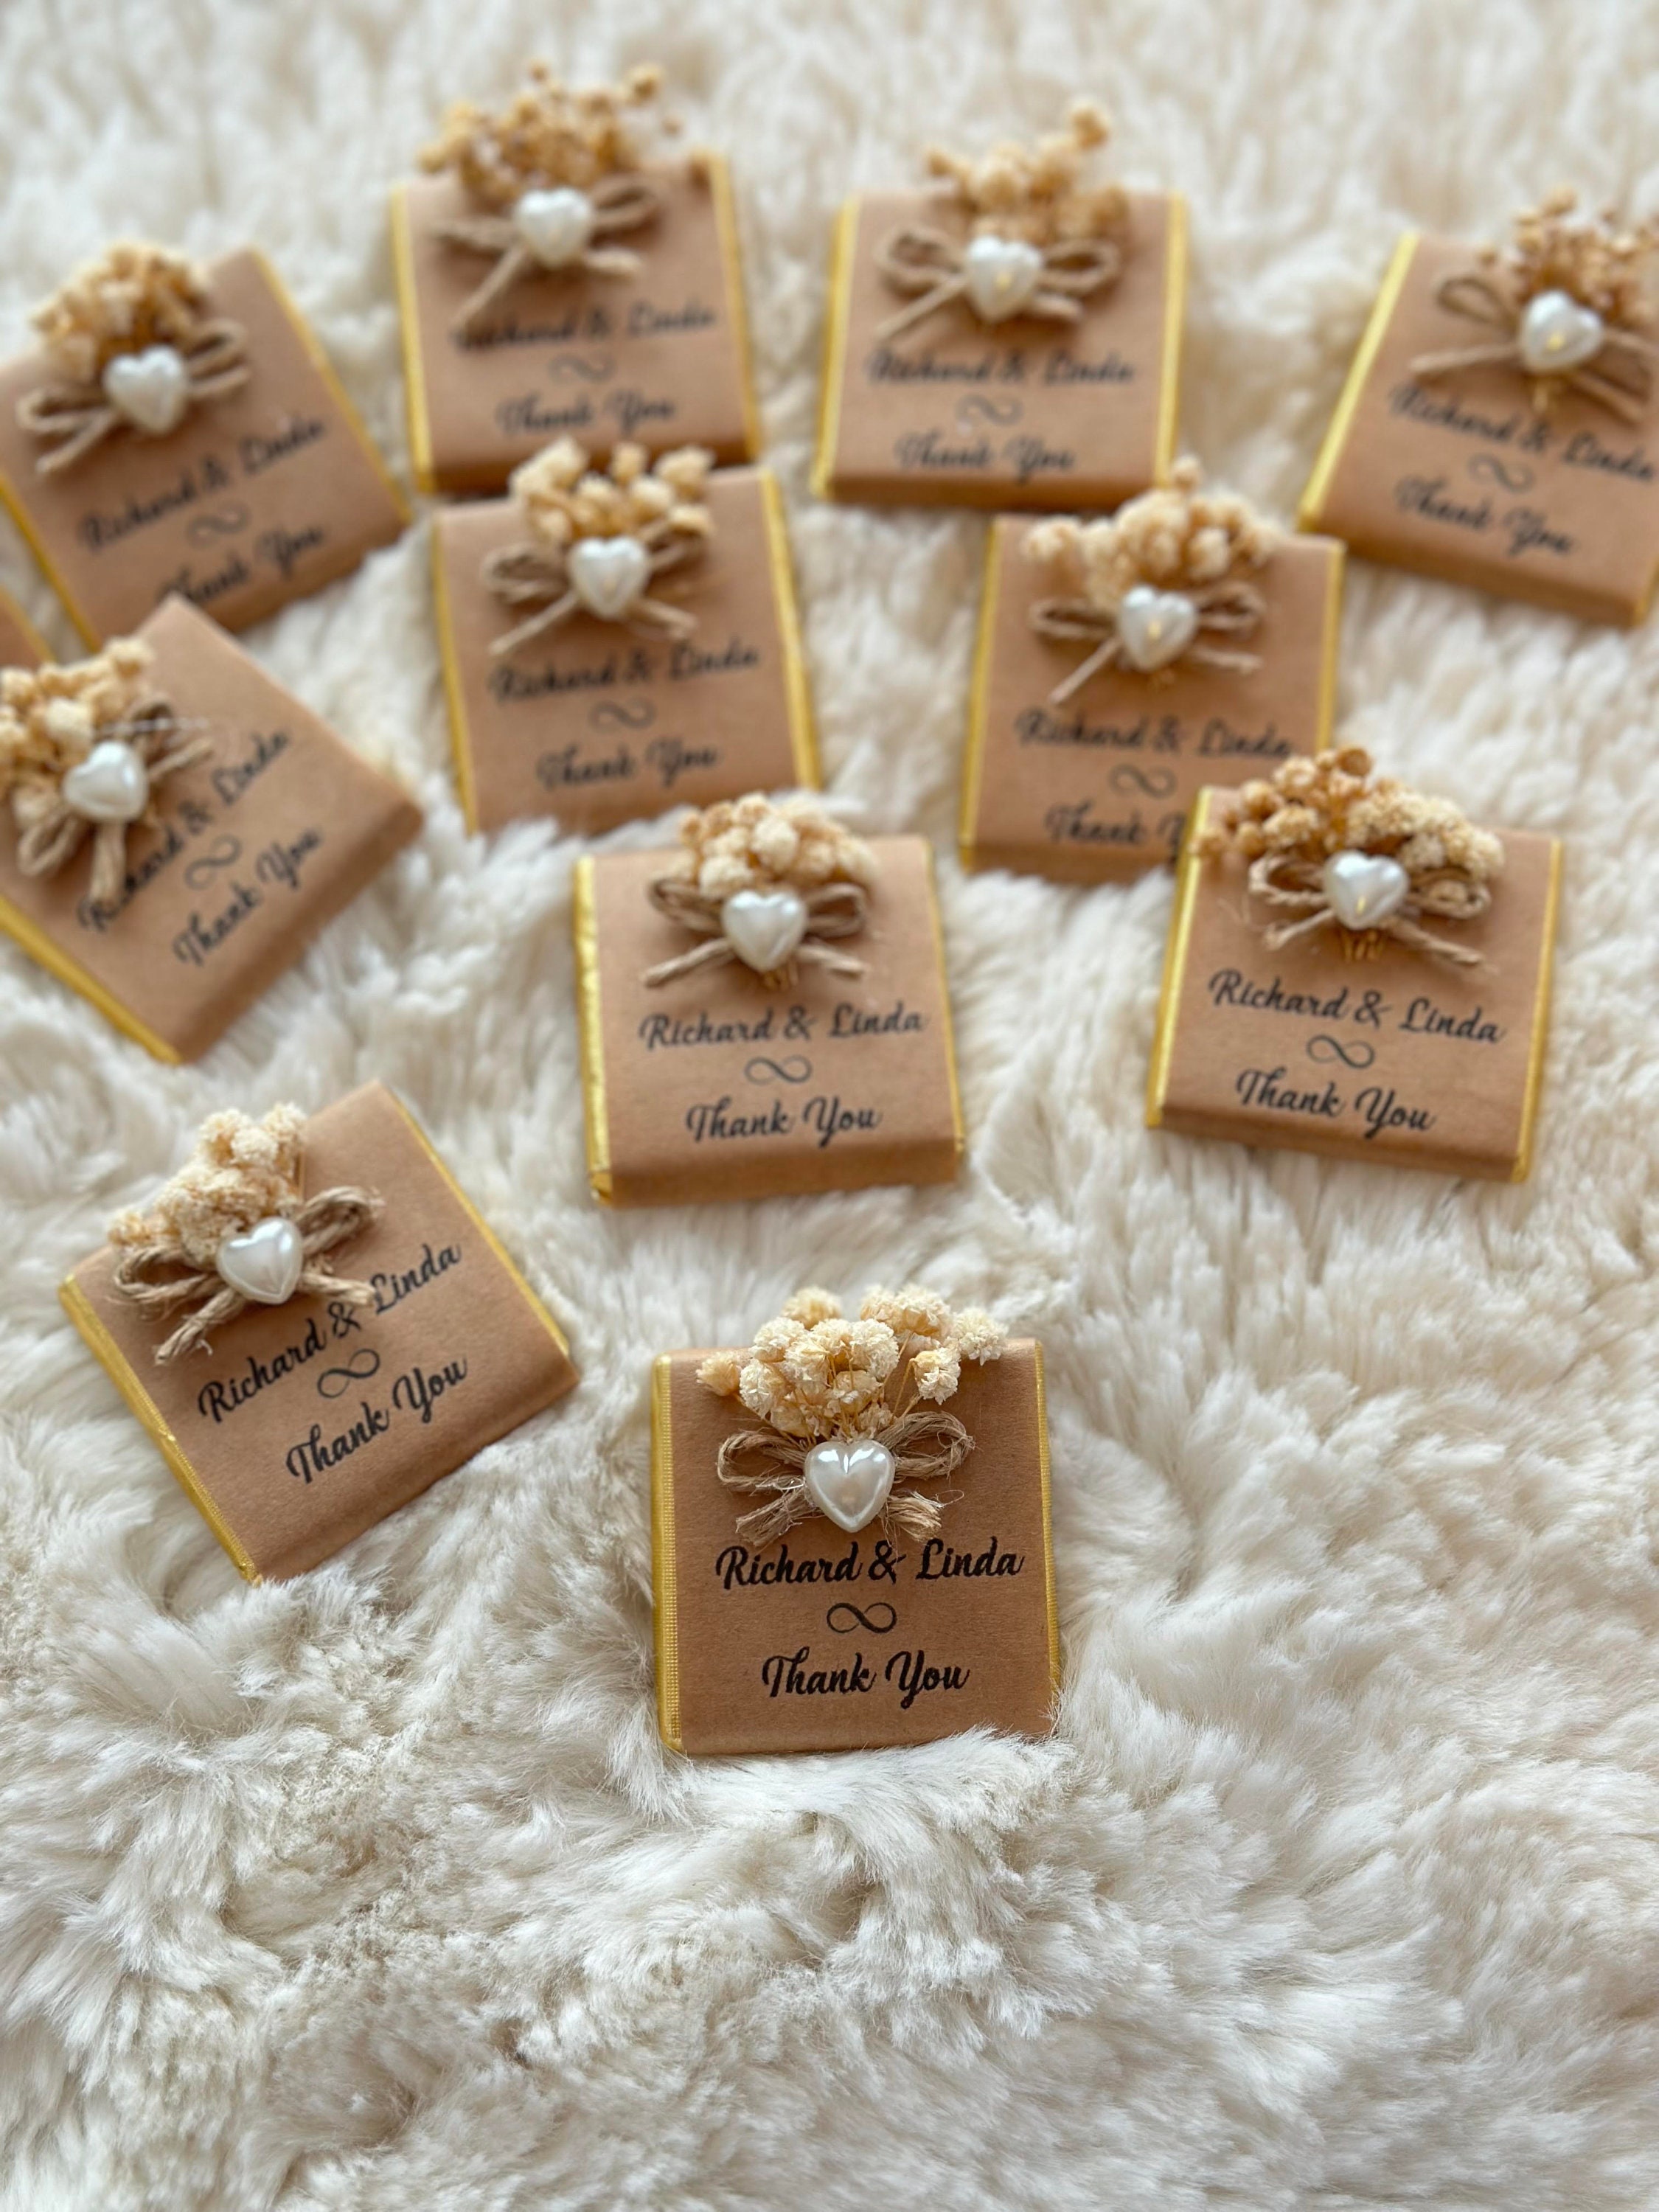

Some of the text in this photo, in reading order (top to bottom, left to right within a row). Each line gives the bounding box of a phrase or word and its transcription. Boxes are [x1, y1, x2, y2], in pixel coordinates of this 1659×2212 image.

[640, 1001, 926, 1051] Richard & Linda
[1208, 969, 1508, 1044] Richard & Linda
[686, 1095, 883, 1148] Thank You
[1237, 1066, 1436, 1139] Thank You
[198, 1242, 462, 1423] Richard & Linda
[285, 1355, 468, 1484] Thank You
[715, 1536, 1026, 1590] Richard & Linda
[762, 1646, 971, 1710] Thank You
